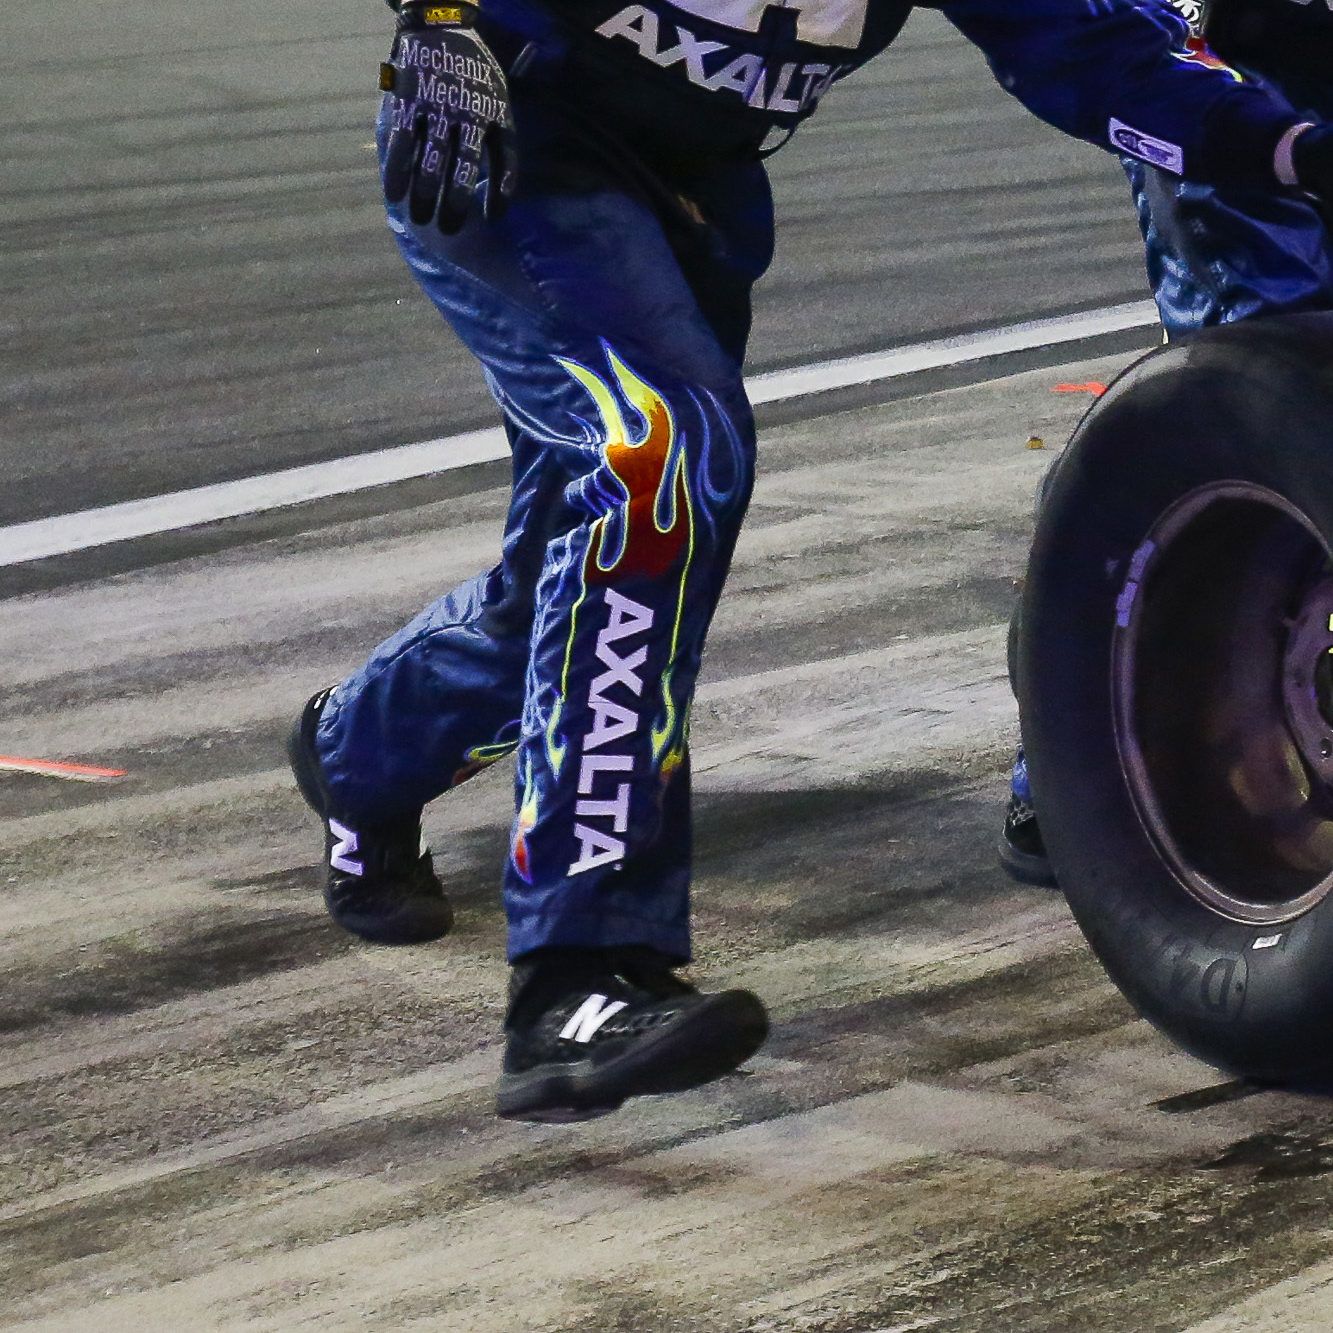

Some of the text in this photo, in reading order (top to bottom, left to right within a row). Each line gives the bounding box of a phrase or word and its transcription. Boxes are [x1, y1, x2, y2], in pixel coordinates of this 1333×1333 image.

[399, 37, 493, 90] Mechanix
[416, 72, 508, 124] Mechanix
[594, 4, 840, 114] AXALTA
[567, 587, 656, 877] AXALTA
